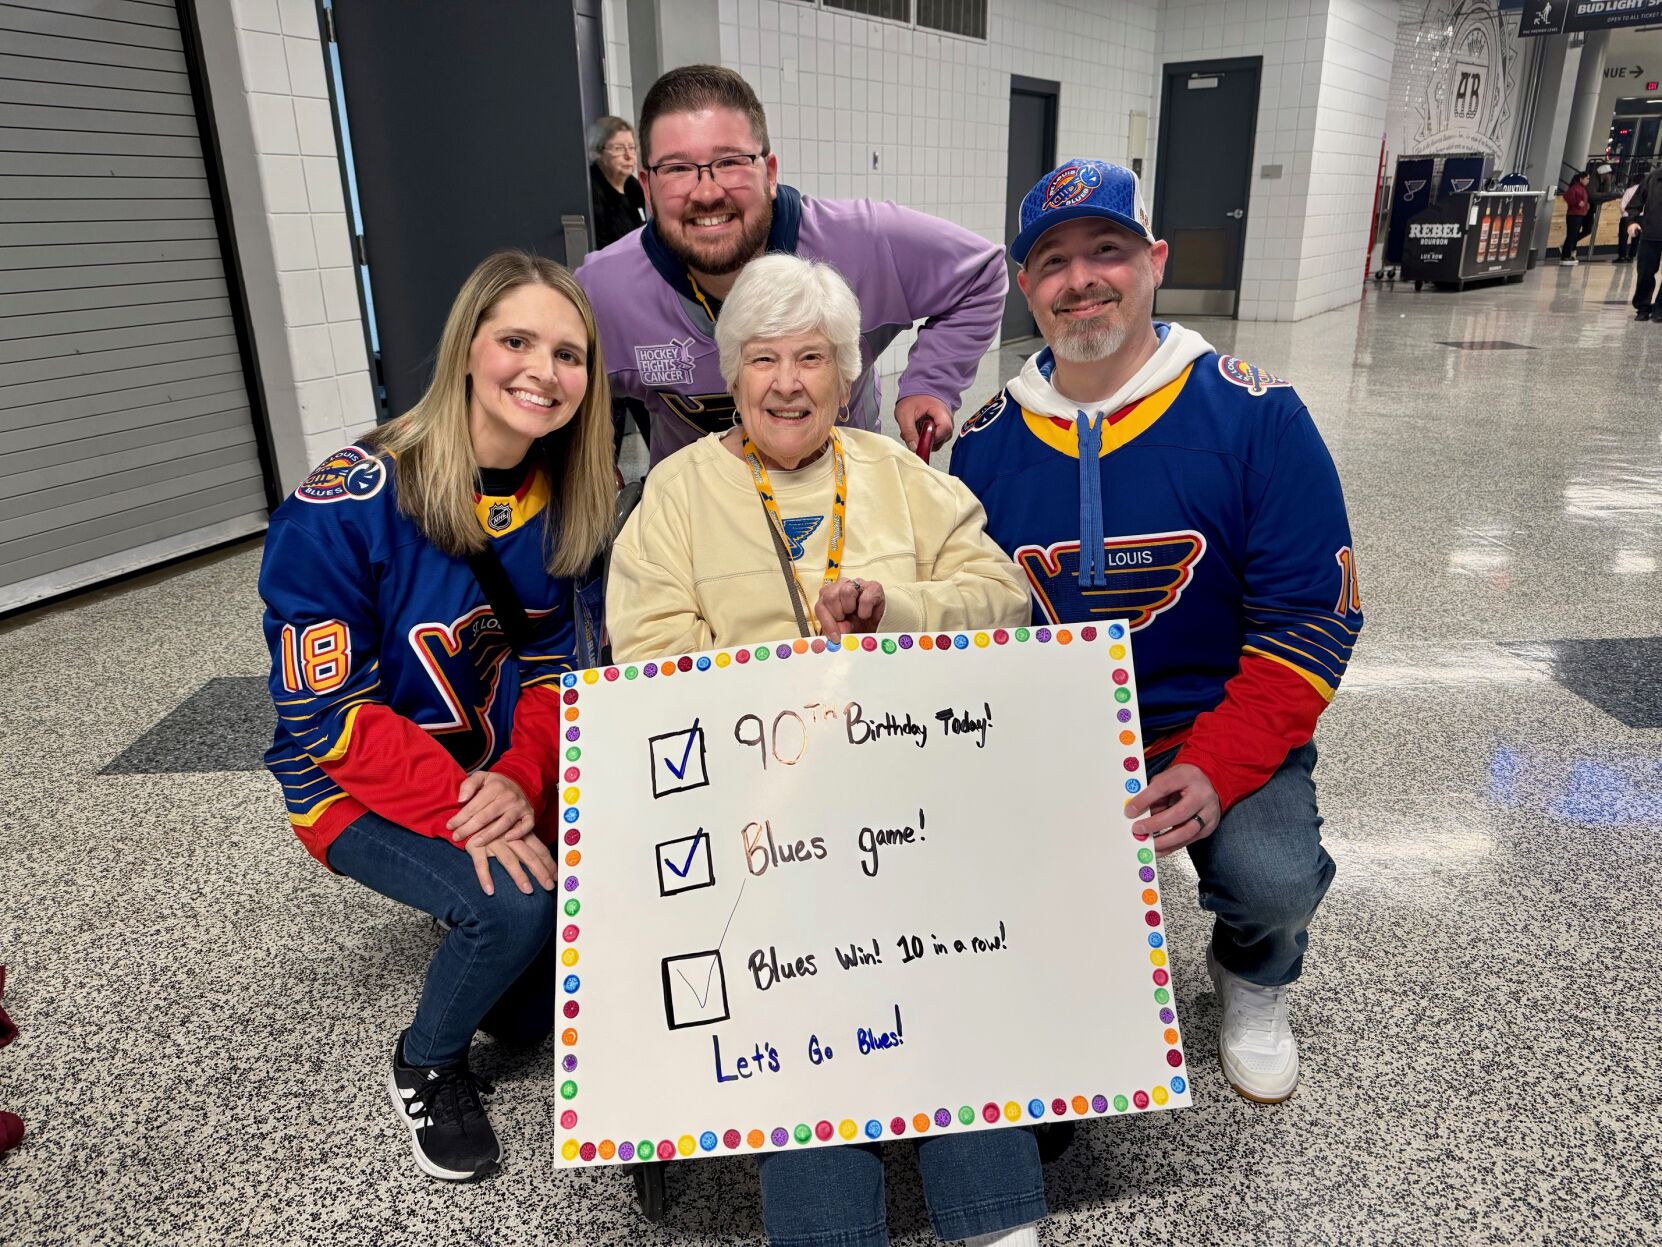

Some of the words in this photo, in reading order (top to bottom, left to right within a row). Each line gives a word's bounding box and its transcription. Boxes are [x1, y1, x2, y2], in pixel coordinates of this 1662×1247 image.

[1577, 2, 1605, 14] BUD
[1605, 0, 1643, 11] LIGHT
[1065, 188, 1090, 206] BLUES
[1408, 223, 1462, 239] REBEL
[640, 349, 678, 361] HOCKEY
[640, 359, 677, 373] FIGHTS
[644, 370, 684, 382] CANCER
[304, 487, 343, 496] BLUES
[1108, 550, 1153, 566] LOUIS
[281, 618, 352, 695] 18
[843, 701, 928, 749] Birthday
[935, 701, 994, 749] Today!
[740, 818, 828, 877] Blues
[858, 808, 926, 878] game!
[748, 945, 818, 991] Blues
[834, 938, 884, 971] Win!
[896, 935, 924, 964] 10
[931, 933, 948, 955] in
[953, 939, 967, 953] a
[971, 920, 1008, 954] row!
[712, 1034, 781, 1083] Let's
[808, 1034, 834, 1066] Go
[857, 1003, 905, 1056] Blues!
